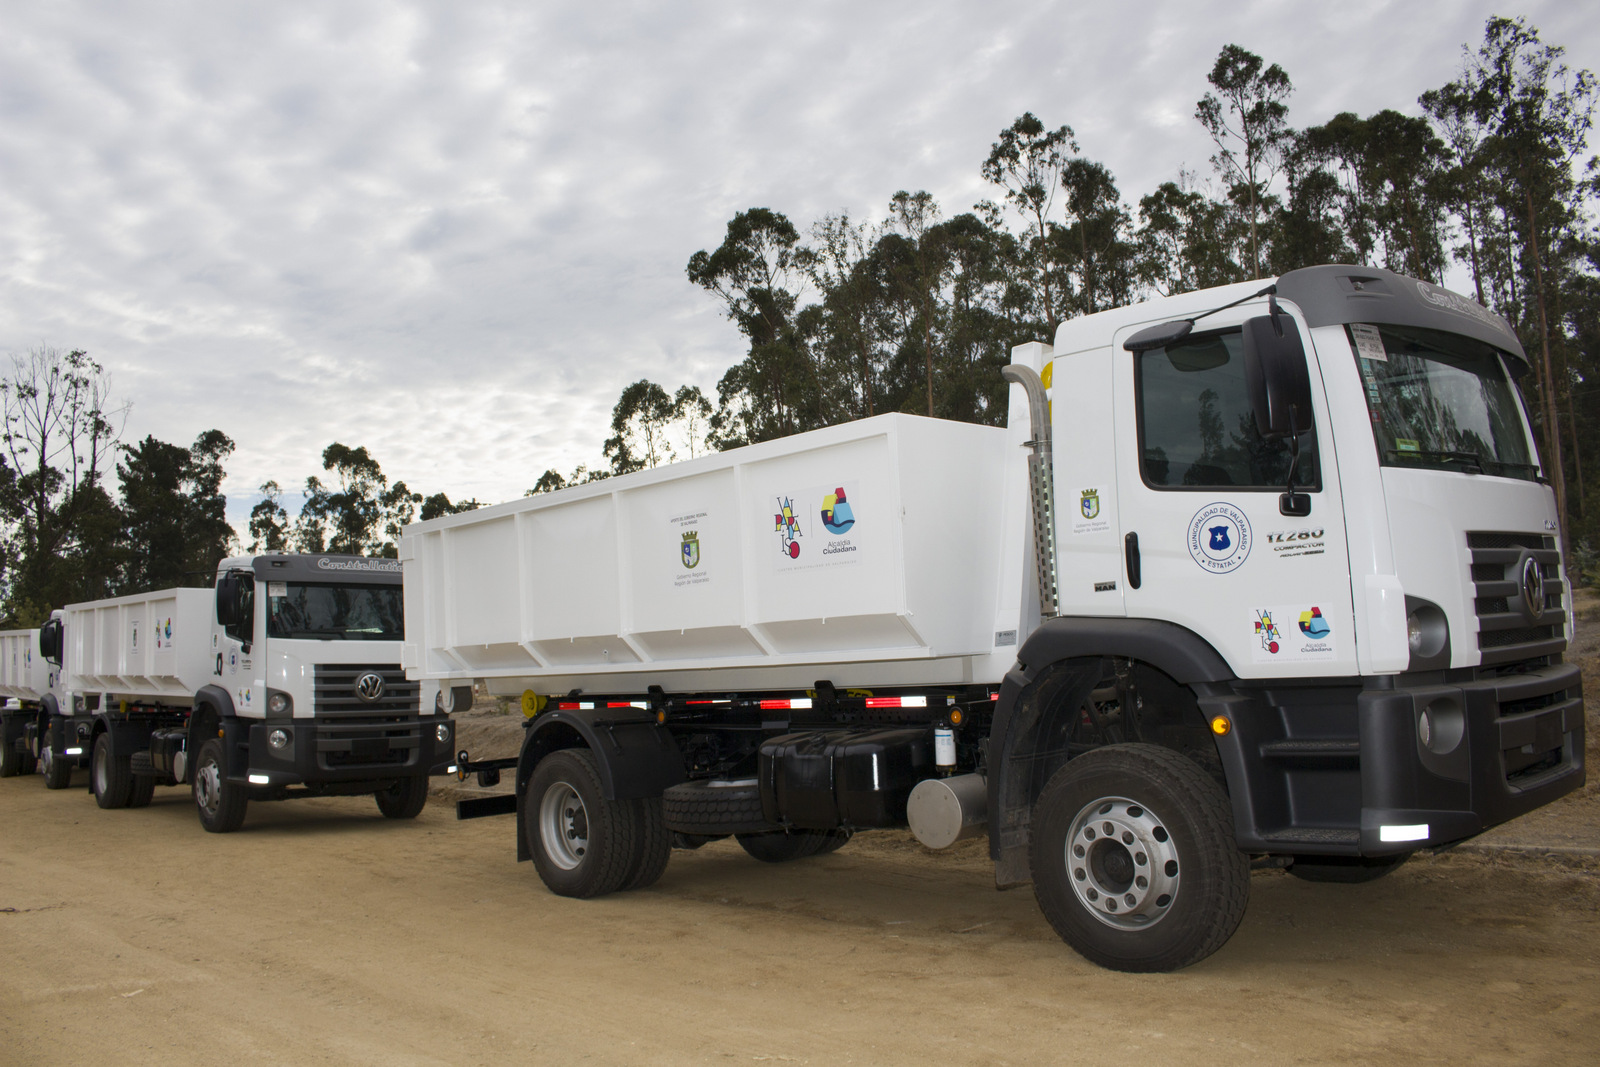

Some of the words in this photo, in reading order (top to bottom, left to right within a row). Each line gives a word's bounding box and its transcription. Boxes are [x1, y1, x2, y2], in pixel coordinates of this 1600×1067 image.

[1191, 507, 1218, 550] MUNICIPALIDAD
[1229, 510, 1248, 551] VALPARAISO
[822, 545, 857, 555] Ciudadana
[1273, 542, 1325, 552] COMPACTOR
[318, 557, 403, 572] Constellatio
[1207, 559, 1237, 568] ESTATAL
[1095, 584, 1116, 592] MAN
